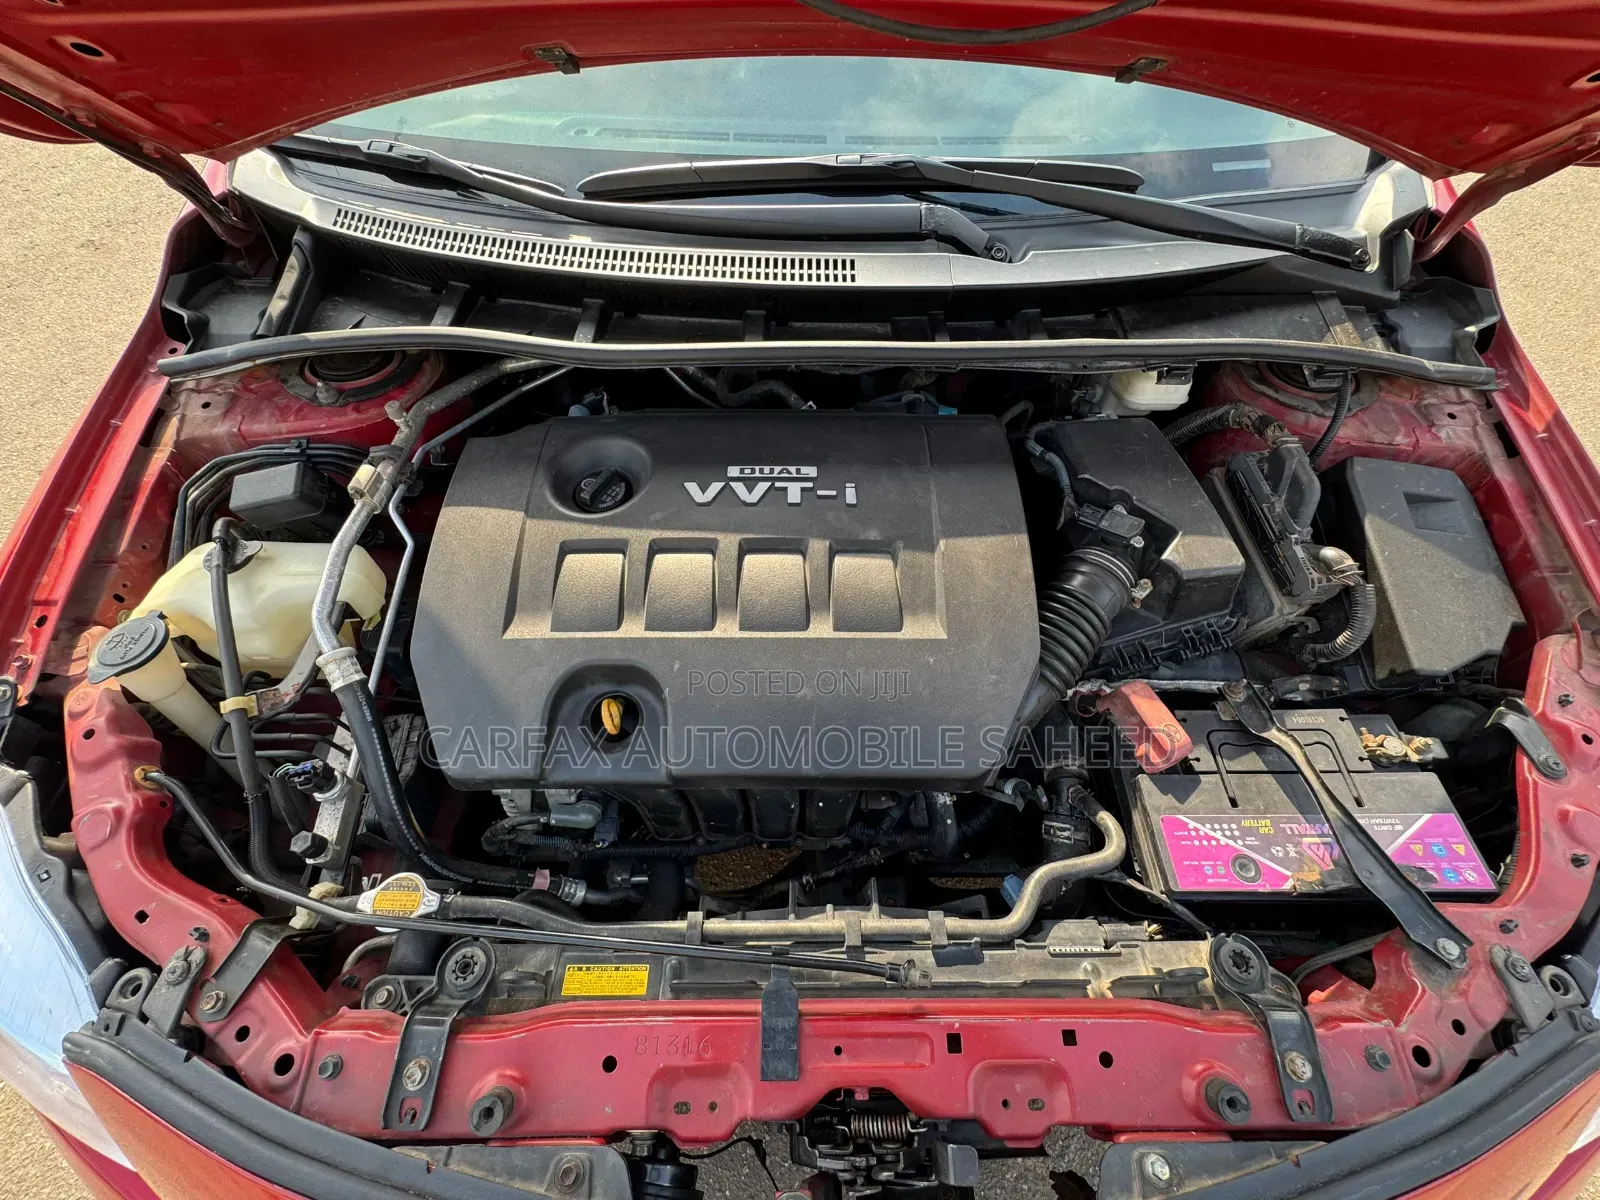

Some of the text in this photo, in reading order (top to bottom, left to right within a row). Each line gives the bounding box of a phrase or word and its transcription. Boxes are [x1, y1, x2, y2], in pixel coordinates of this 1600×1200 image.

[737, 466, 811, 477] DUAL
[683, 481, 857, 506] VVT-i
[1240, 819, 1272, 827] BATTERY
[1258, 826, 1274, 834] CAR
[375, 909, 410, 917] CAUTION
[635, 1034, 712, 1057] 81316
